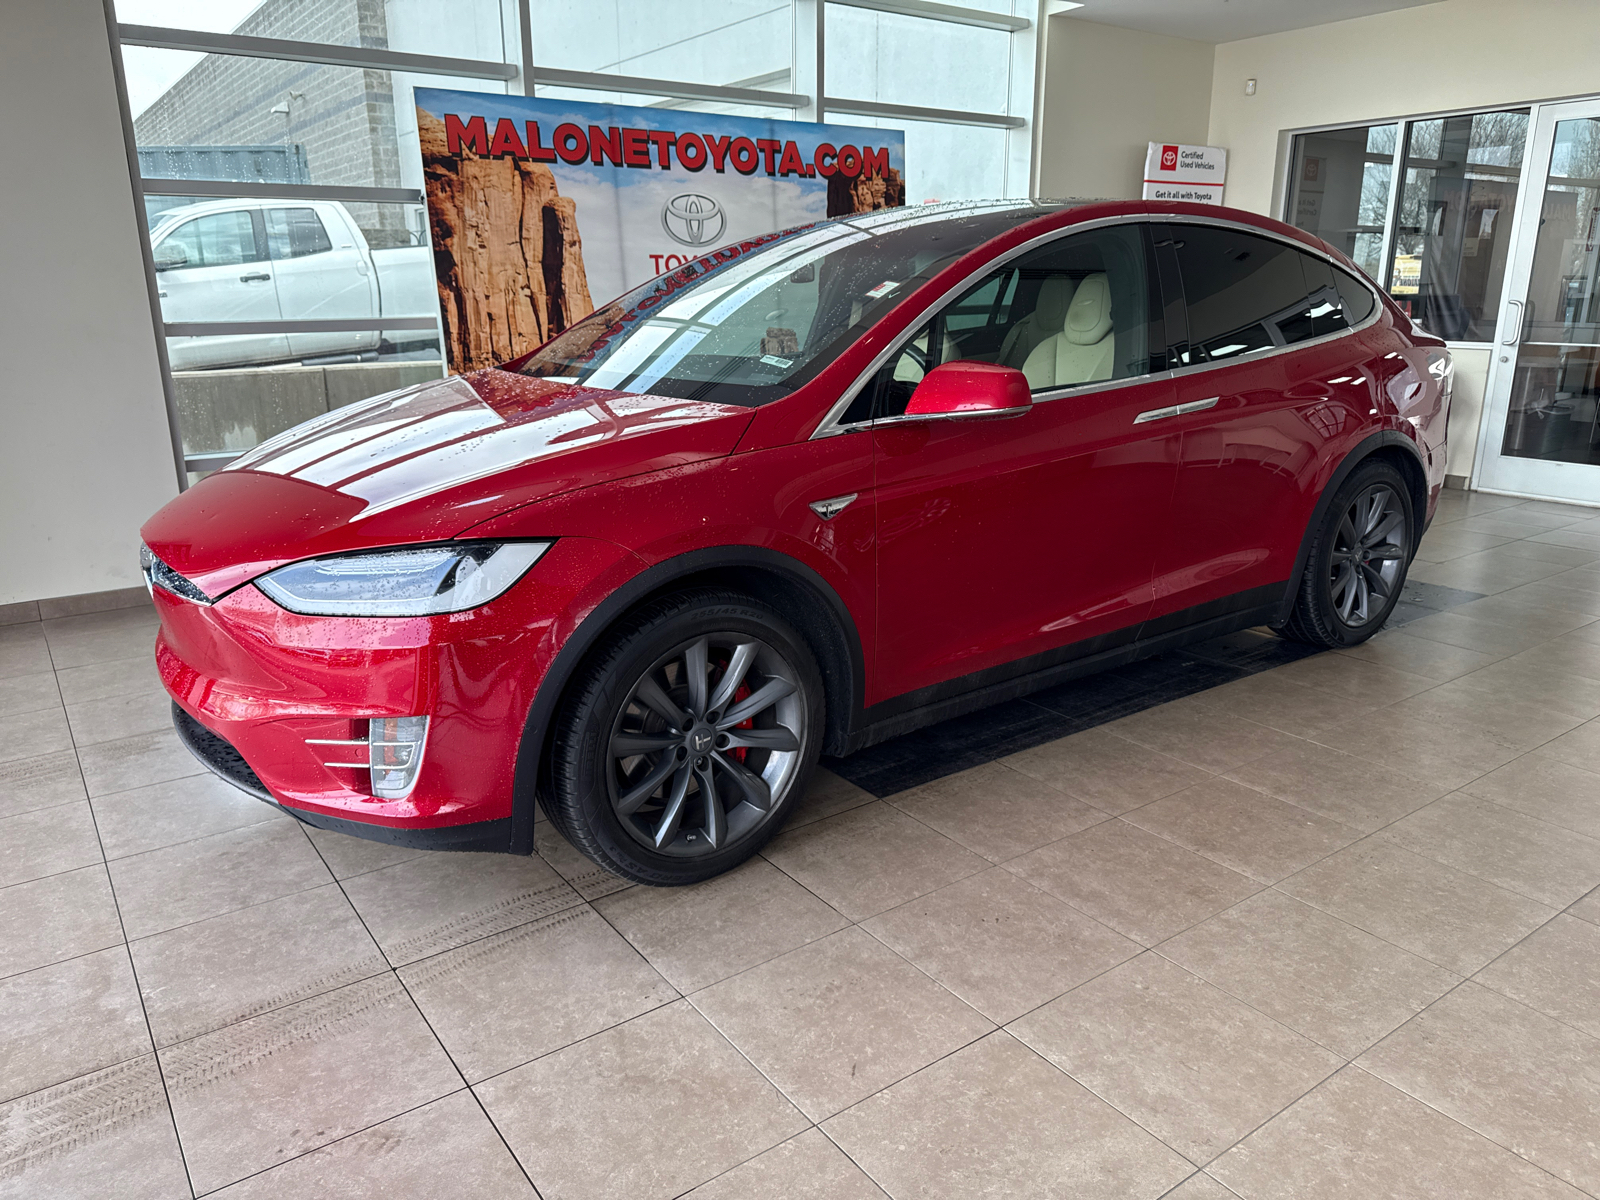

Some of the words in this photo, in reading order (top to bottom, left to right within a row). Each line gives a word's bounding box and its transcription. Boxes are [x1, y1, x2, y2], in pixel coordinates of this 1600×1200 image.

[444, 113, 890, 182] MALONETOYOTA.COM
[1181, 151, 1204, 160] Certified
[1180, 160, 1194, 169] Used
[1194, 161, 1215, 170] Vehicles
[1155, 190, 1166, 199] Get
[1167, 191, 1172, 199] it
[1172, 191, 1180, 199] all
[1181, 191, 1194, 200] with
[1194, 192, 1212, 201] Toyota
[691, 608, 738, 620] 255/45
[739, 609, 763, 620] R20
